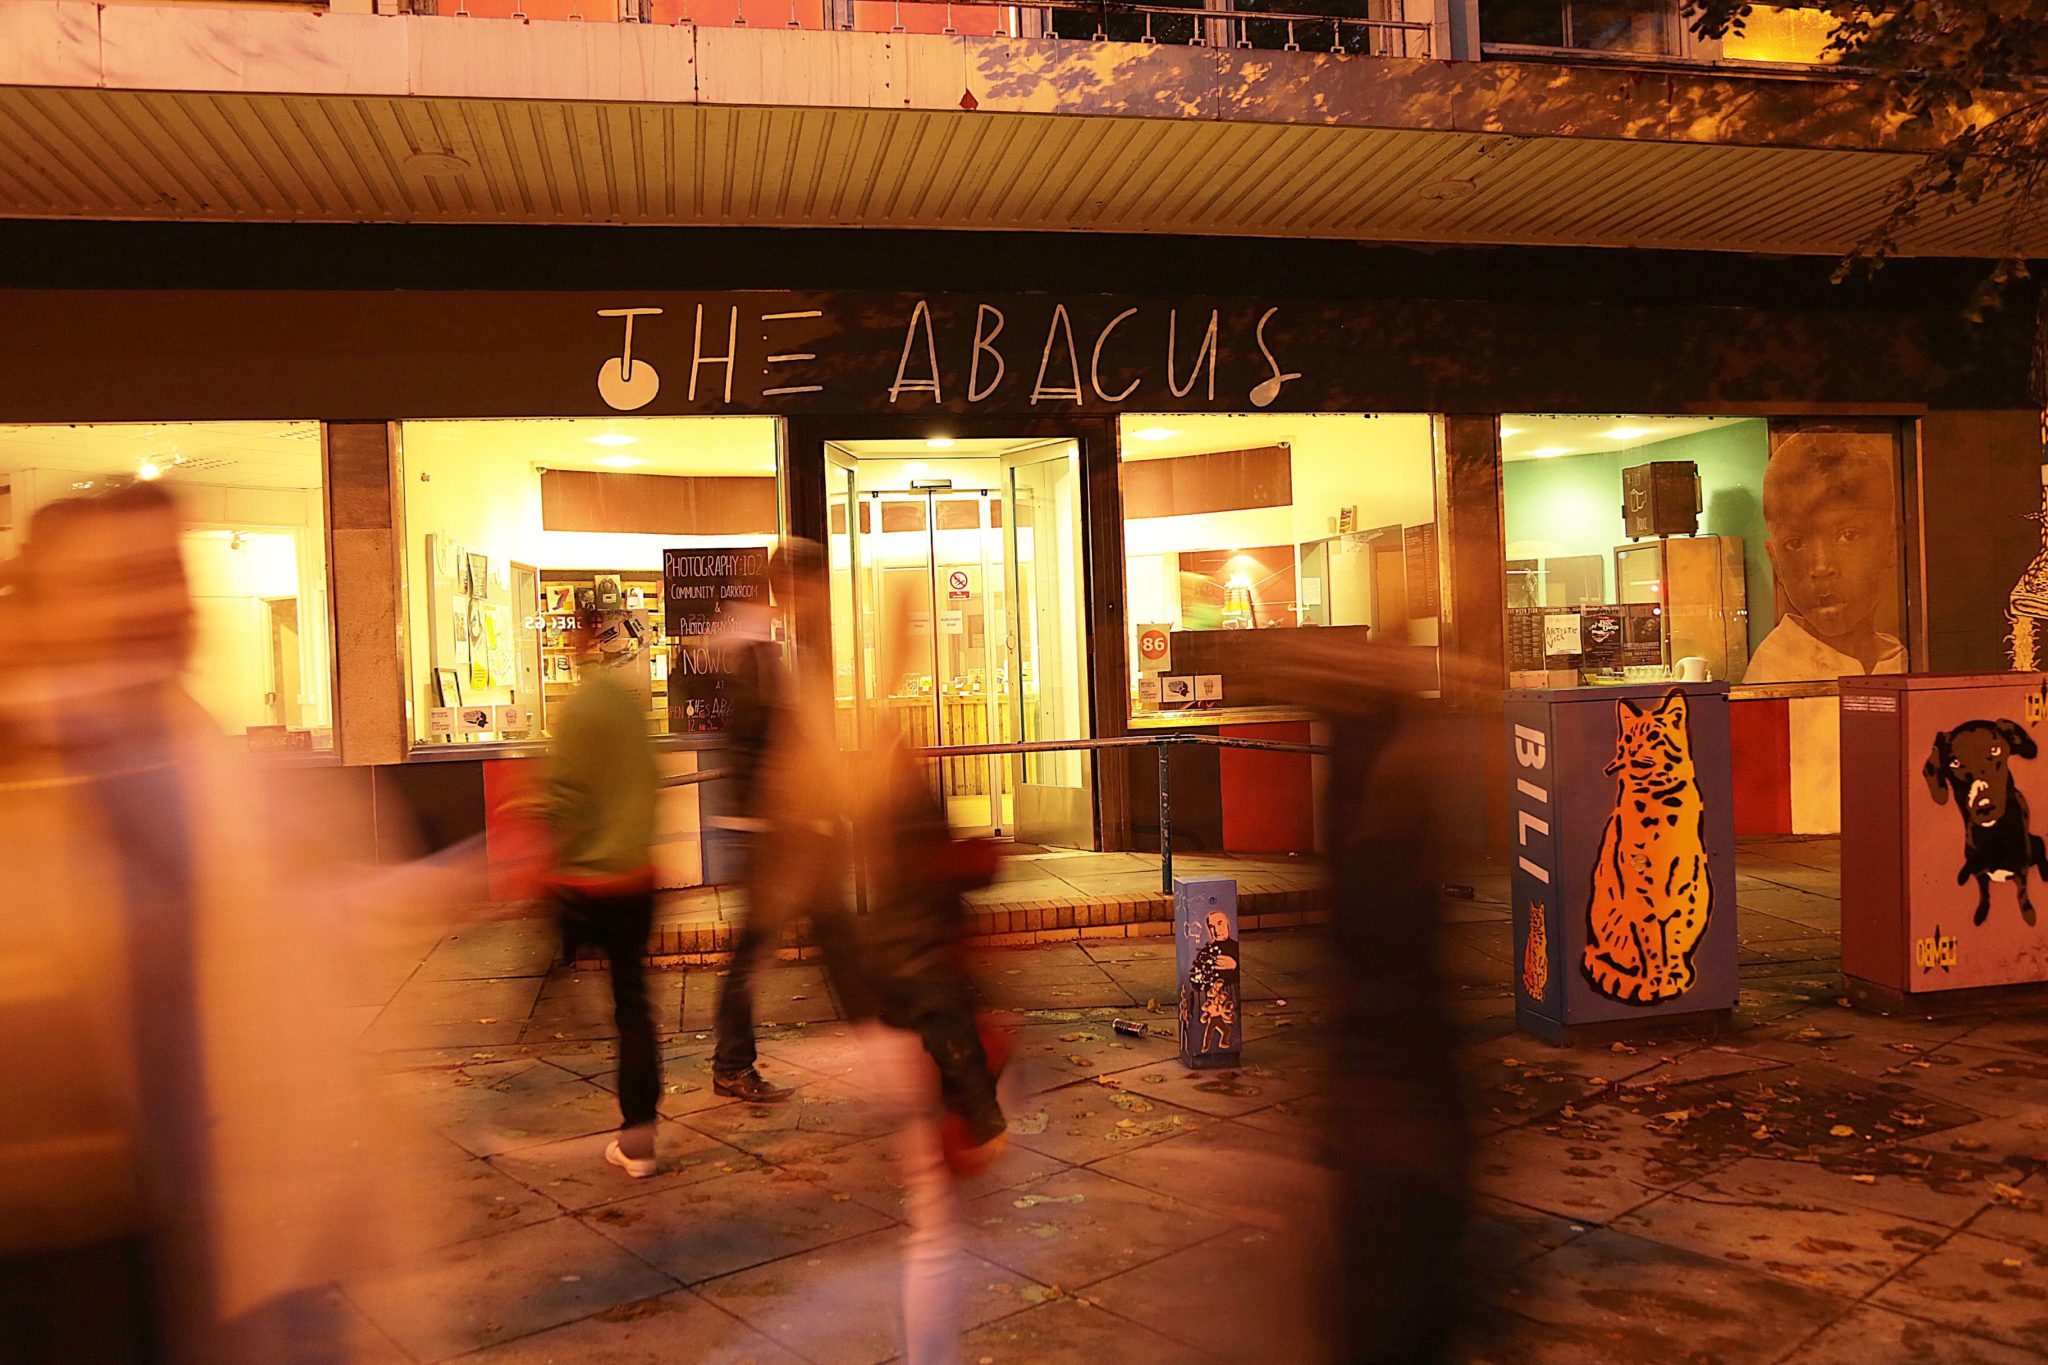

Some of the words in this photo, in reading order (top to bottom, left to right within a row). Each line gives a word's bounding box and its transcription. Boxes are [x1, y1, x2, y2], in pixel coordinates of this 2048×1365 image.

[597, 304, 823, 411] THE
[888, 300, 1302, 407] ABACUS
[670, 583, 715, 600] COMMUNITY
[720, 584, 758, 599] DARKROOM
[714, 601, 721, 613] &
[1545, 626, 1578, 639] ARTISTIC
[1142, 638, 1165, 651] 86
[1546, 633, 1565, 649] VICE
[683, 647, 720, 675] NOW
[715, 680, 725, 689] AT
[1514, 724, 1549, 884] BILI
